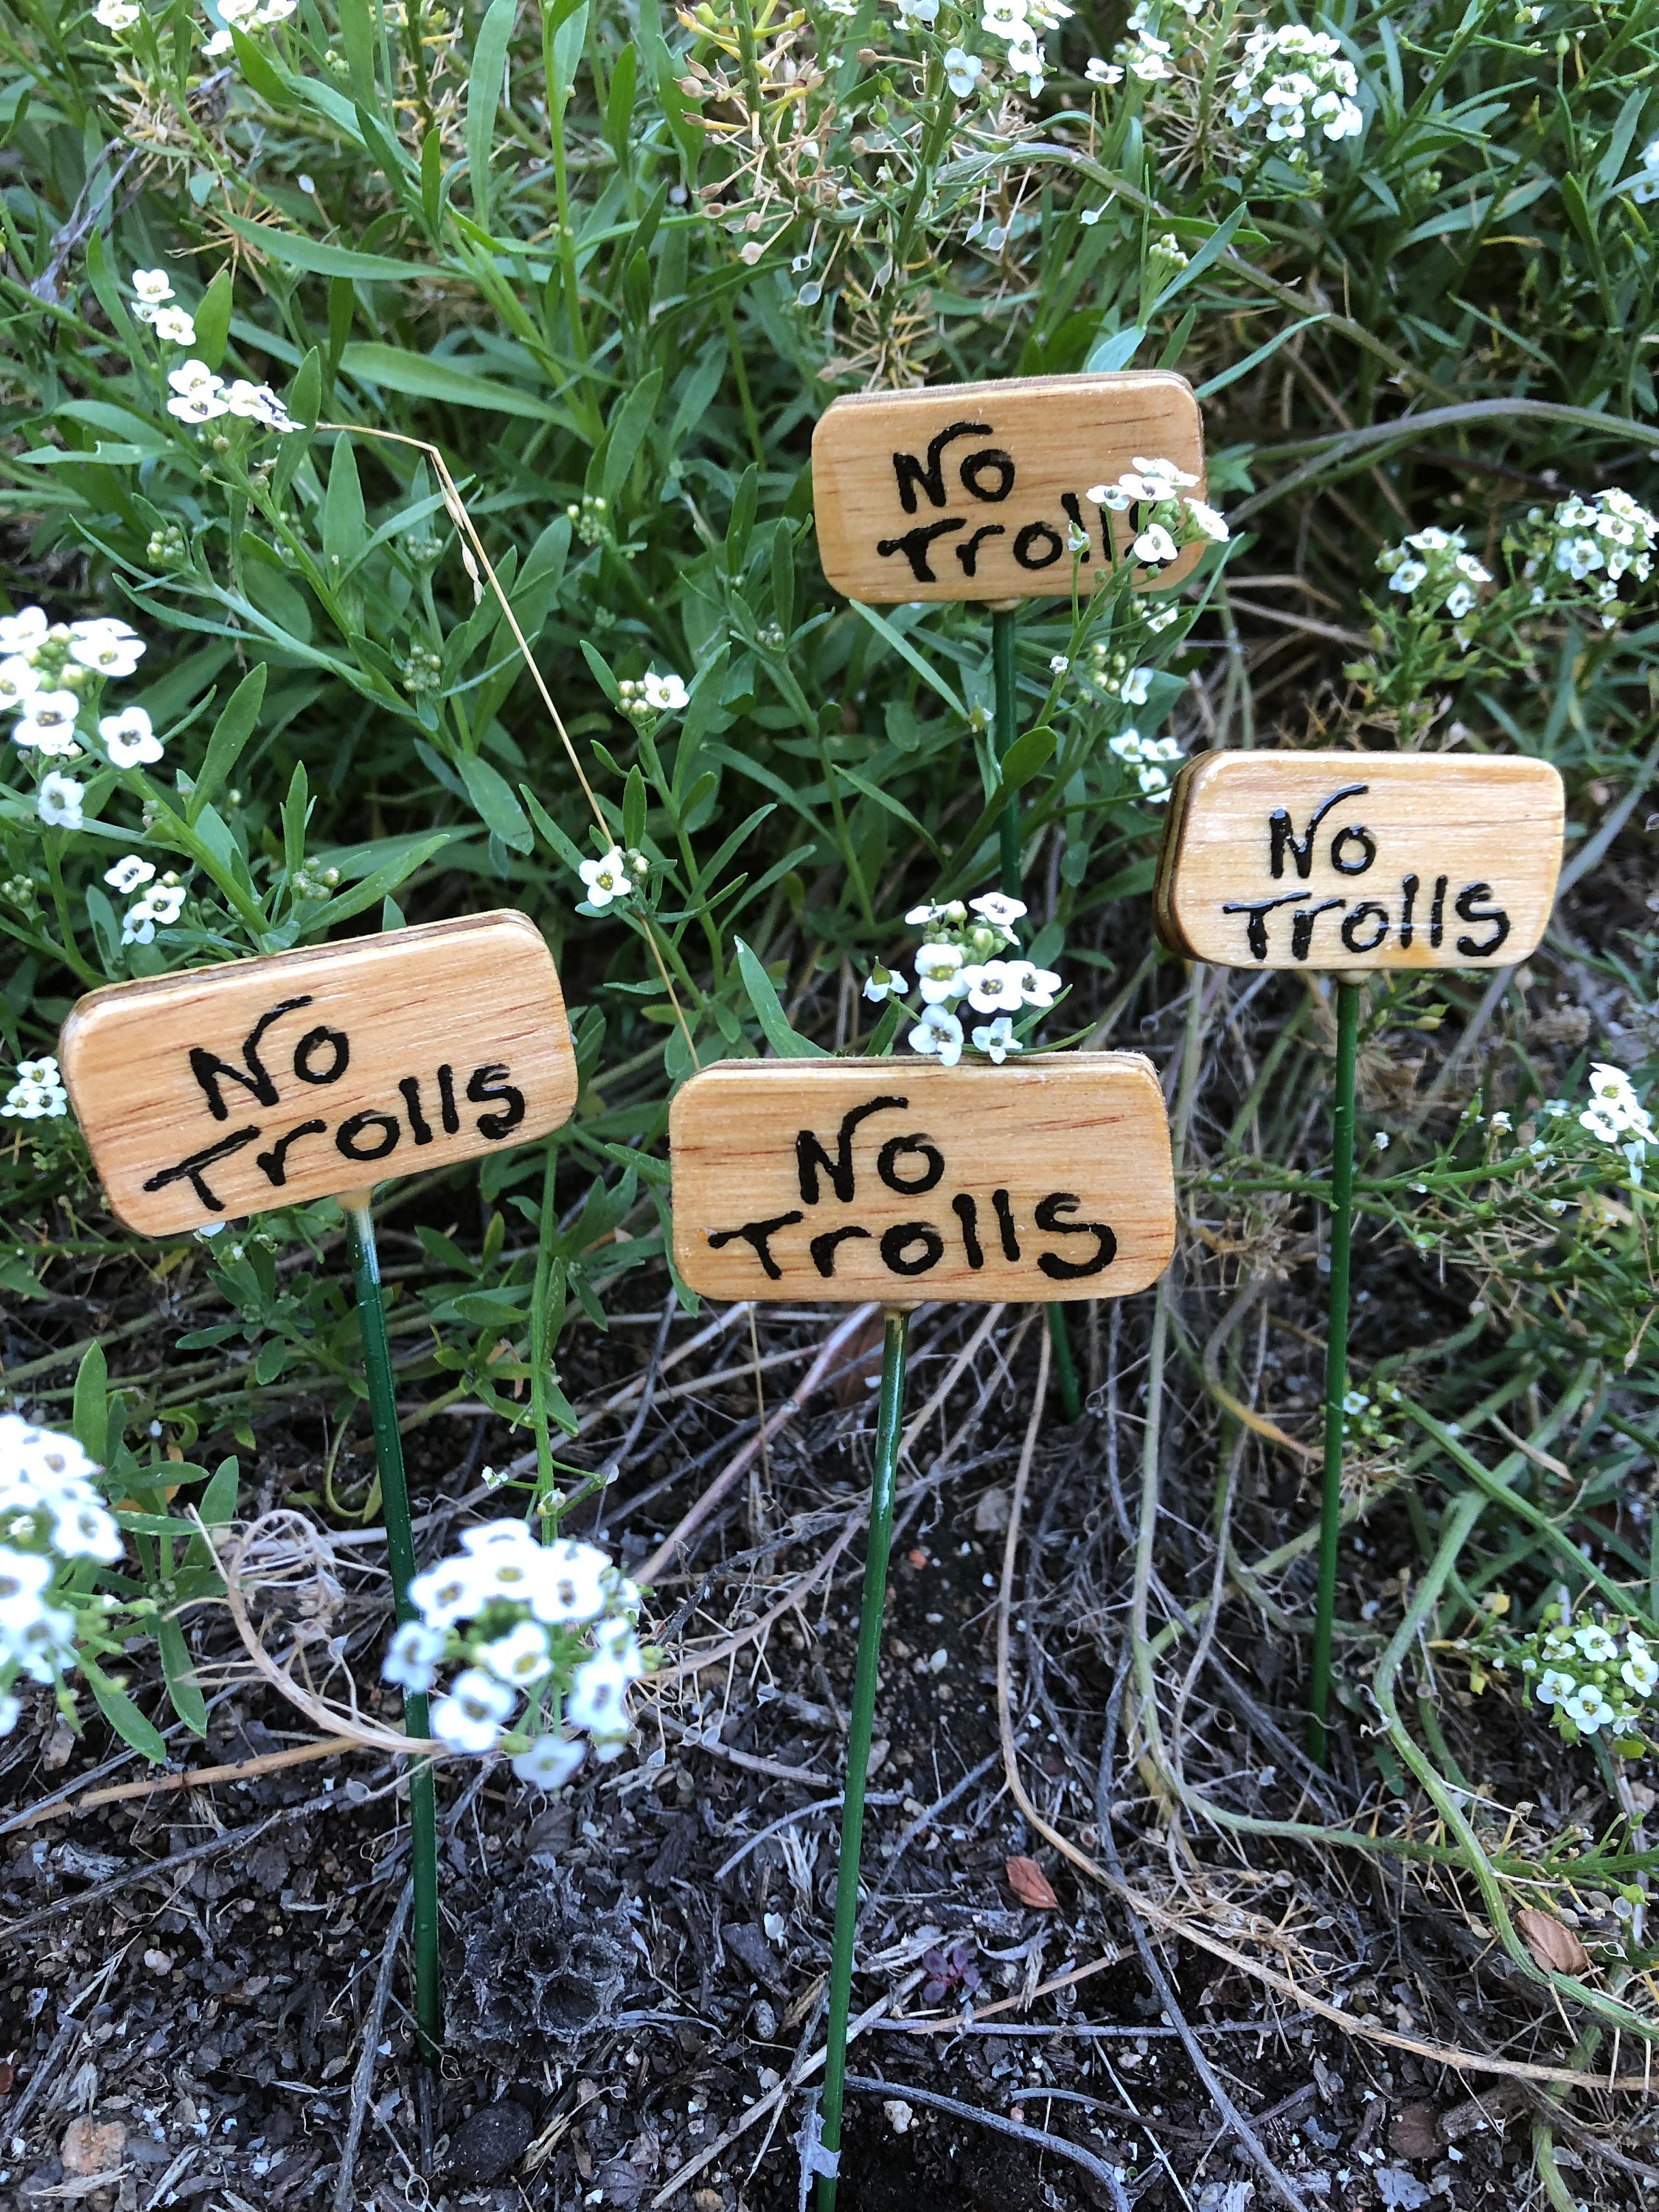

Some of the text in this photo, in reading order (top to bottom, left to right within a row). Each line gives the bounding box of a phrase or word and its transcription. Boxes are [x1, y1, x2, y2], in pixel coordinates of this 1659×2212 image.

[893, 422, 1015, 514] No
[1269, 784, 1377, 879] No
[1222, 874, 1510, 960] Trolls
[189, 995, 349, 1121] No
[143, 1063, 526, 1212] Trolls
[796, 1096, 945, 1205] No
[708, 1189, 1117, 1280] Trolls
